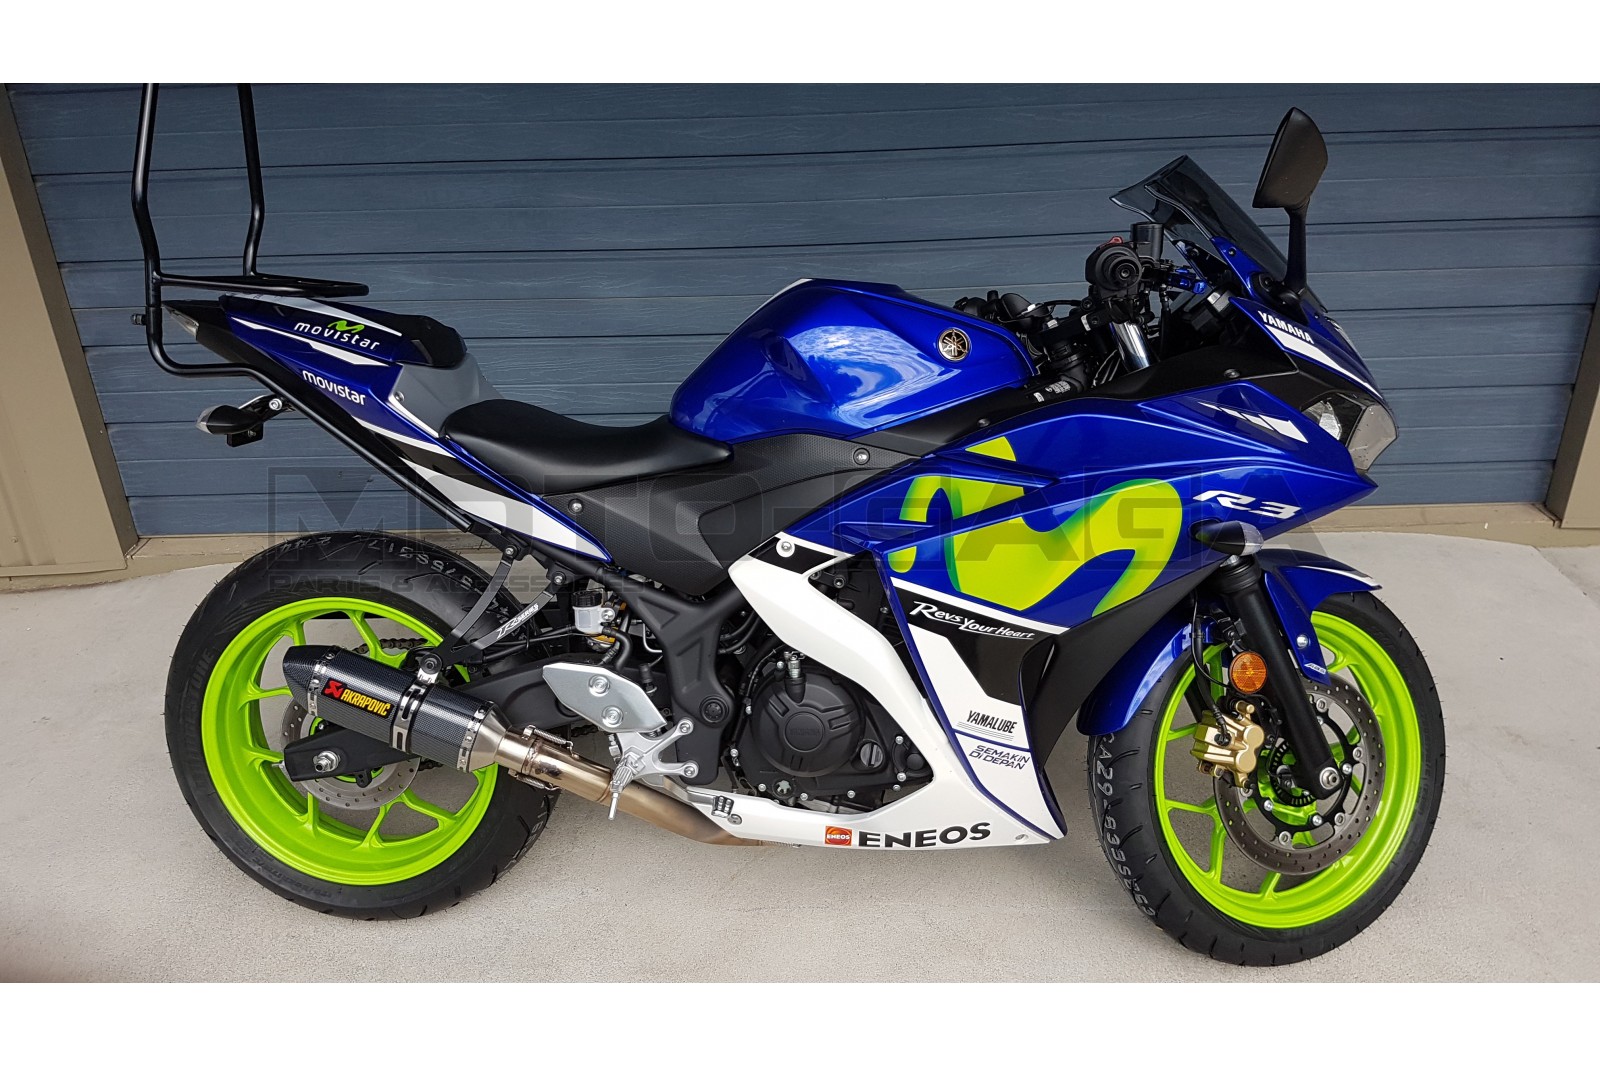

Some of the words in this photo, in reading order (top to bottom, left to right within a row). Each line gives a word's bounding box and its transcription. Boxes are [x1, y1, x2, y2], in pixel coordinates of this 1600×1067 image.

[294, 322, 380, 350] movistar
[1258, 310, 1315, 344] YAMAHA
[302, 370, 366, 406] movistar
[966, 710, 1018, 734] YAMALUBE
[982, 755, 1026, 770] DEPAN
[858, 821, 991, 848] ENEOS
